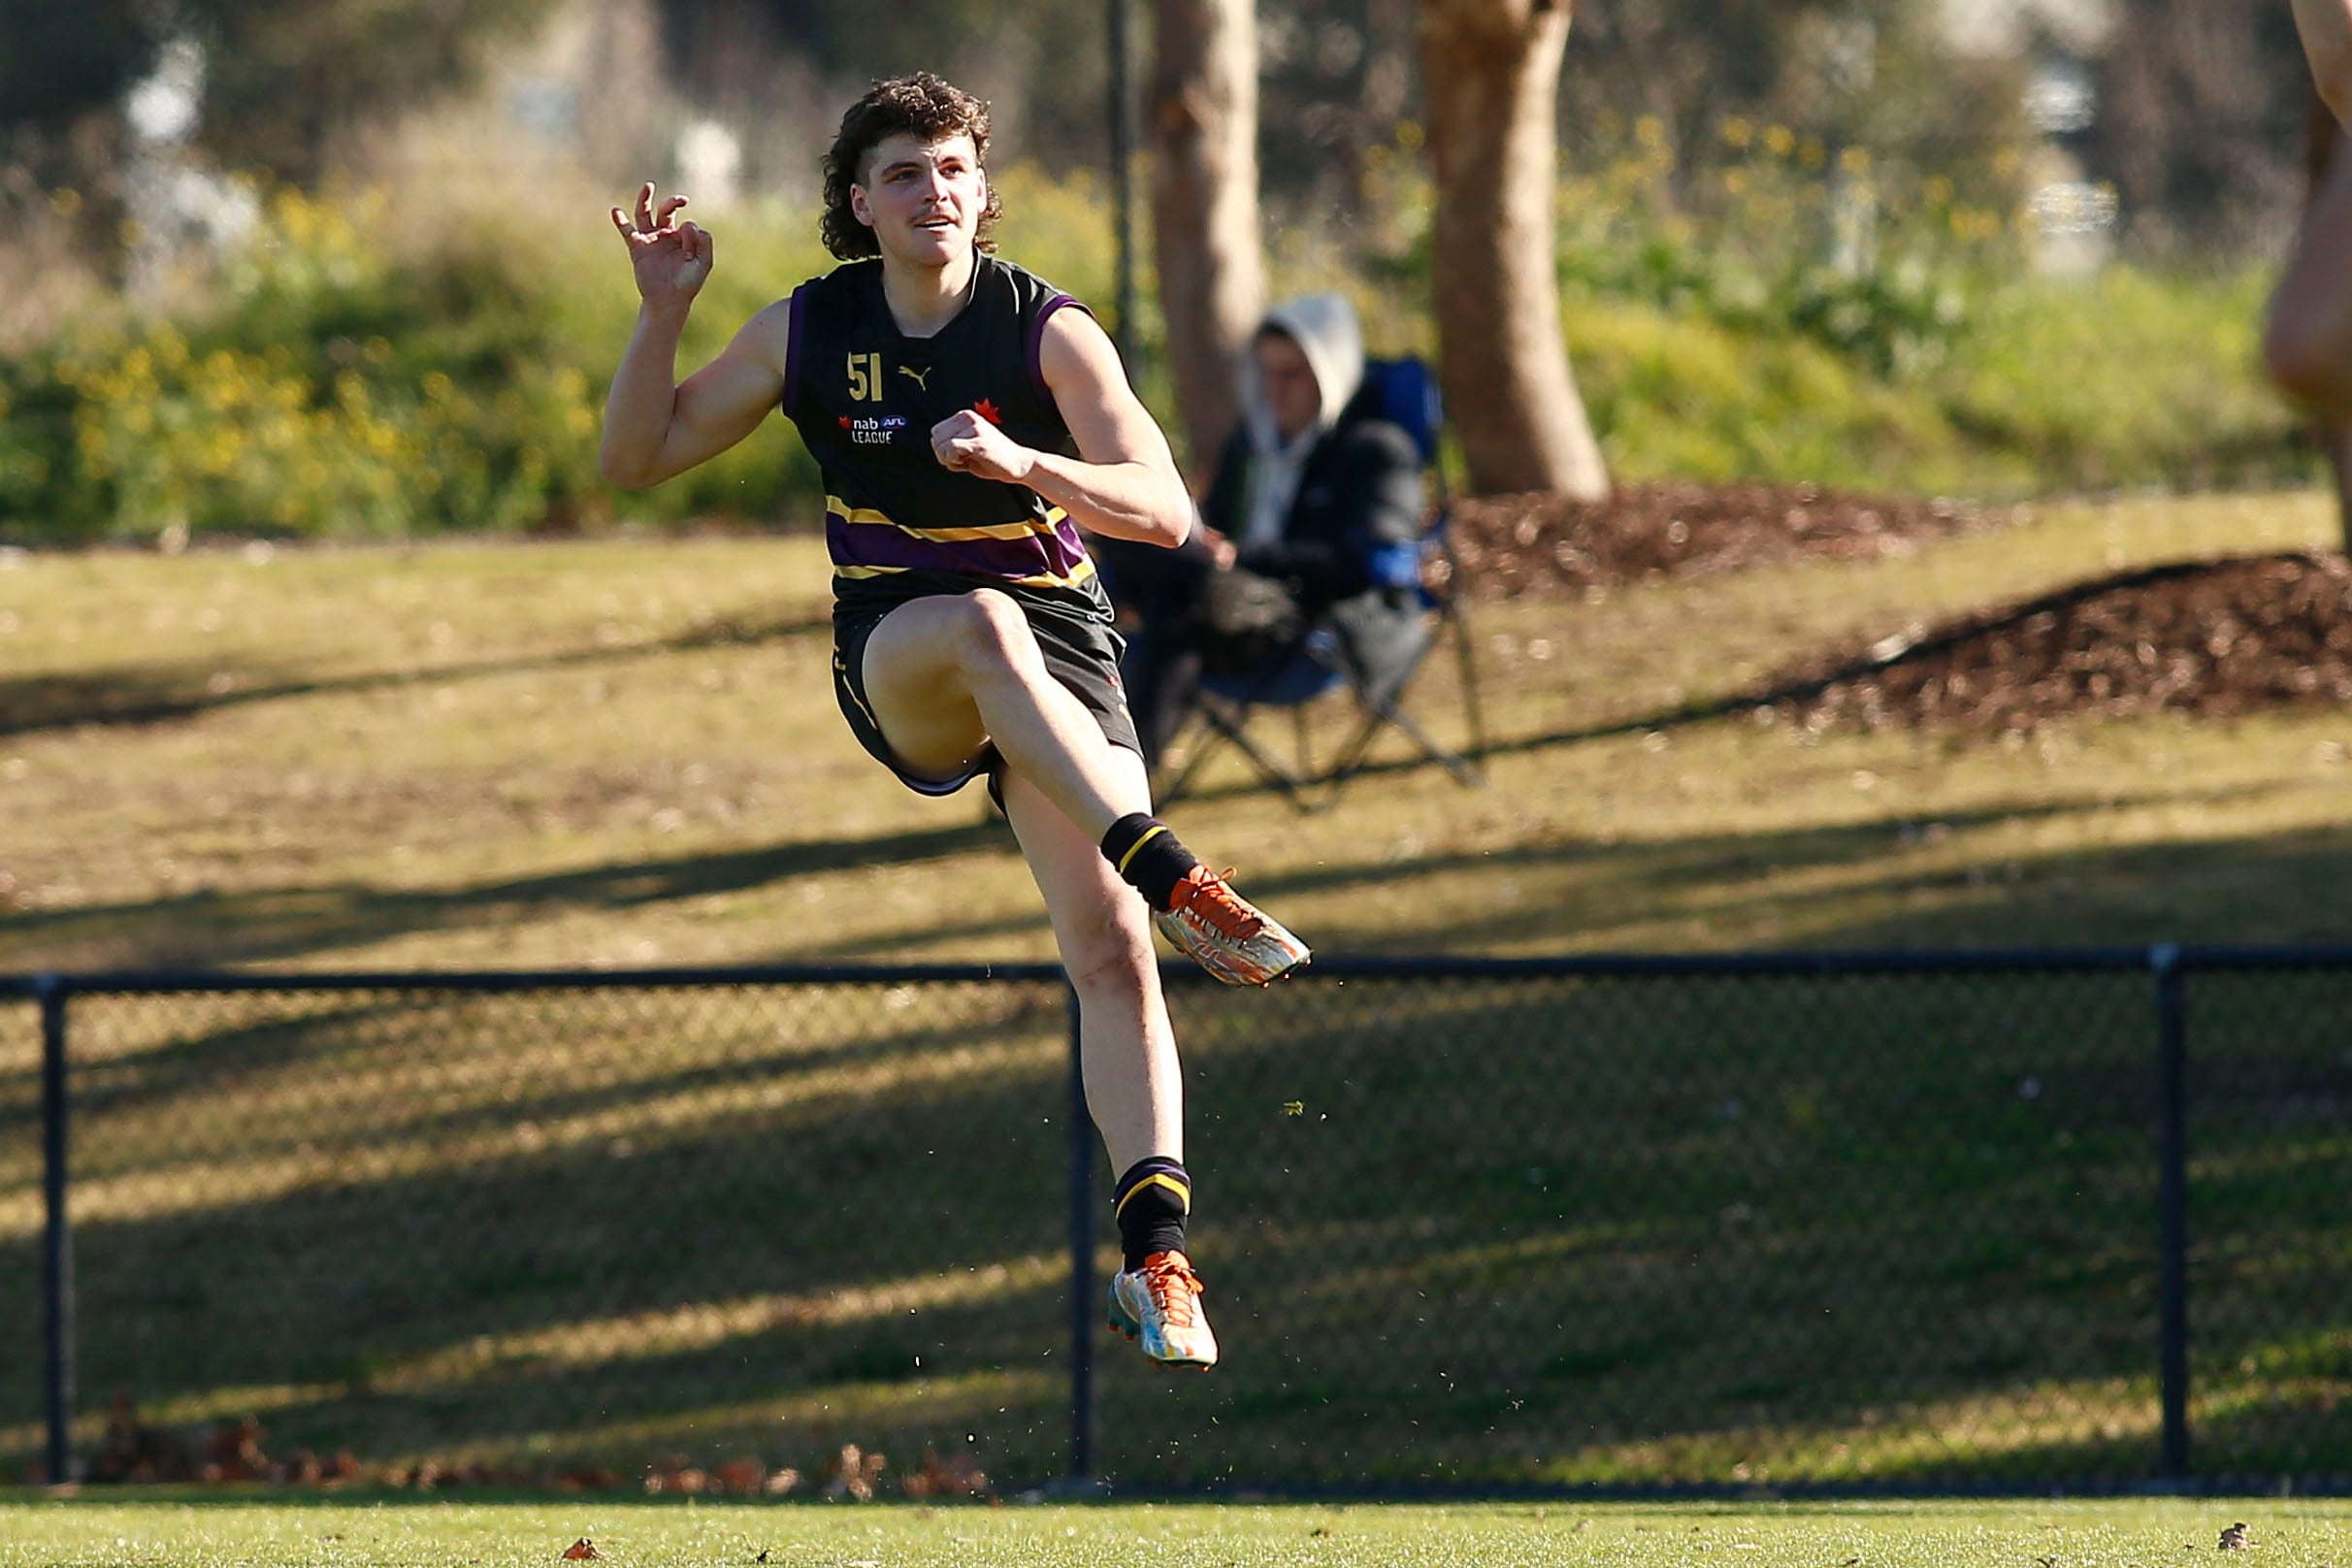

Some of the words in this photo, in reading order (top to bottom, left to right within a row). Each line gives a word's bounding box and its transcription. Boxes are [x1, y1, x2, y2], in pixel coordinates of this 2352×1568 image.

[847, 352, 883, 402] 51
[853, 417, 879, 430] nab
[852, 431, 893, 444] LEAGUE
